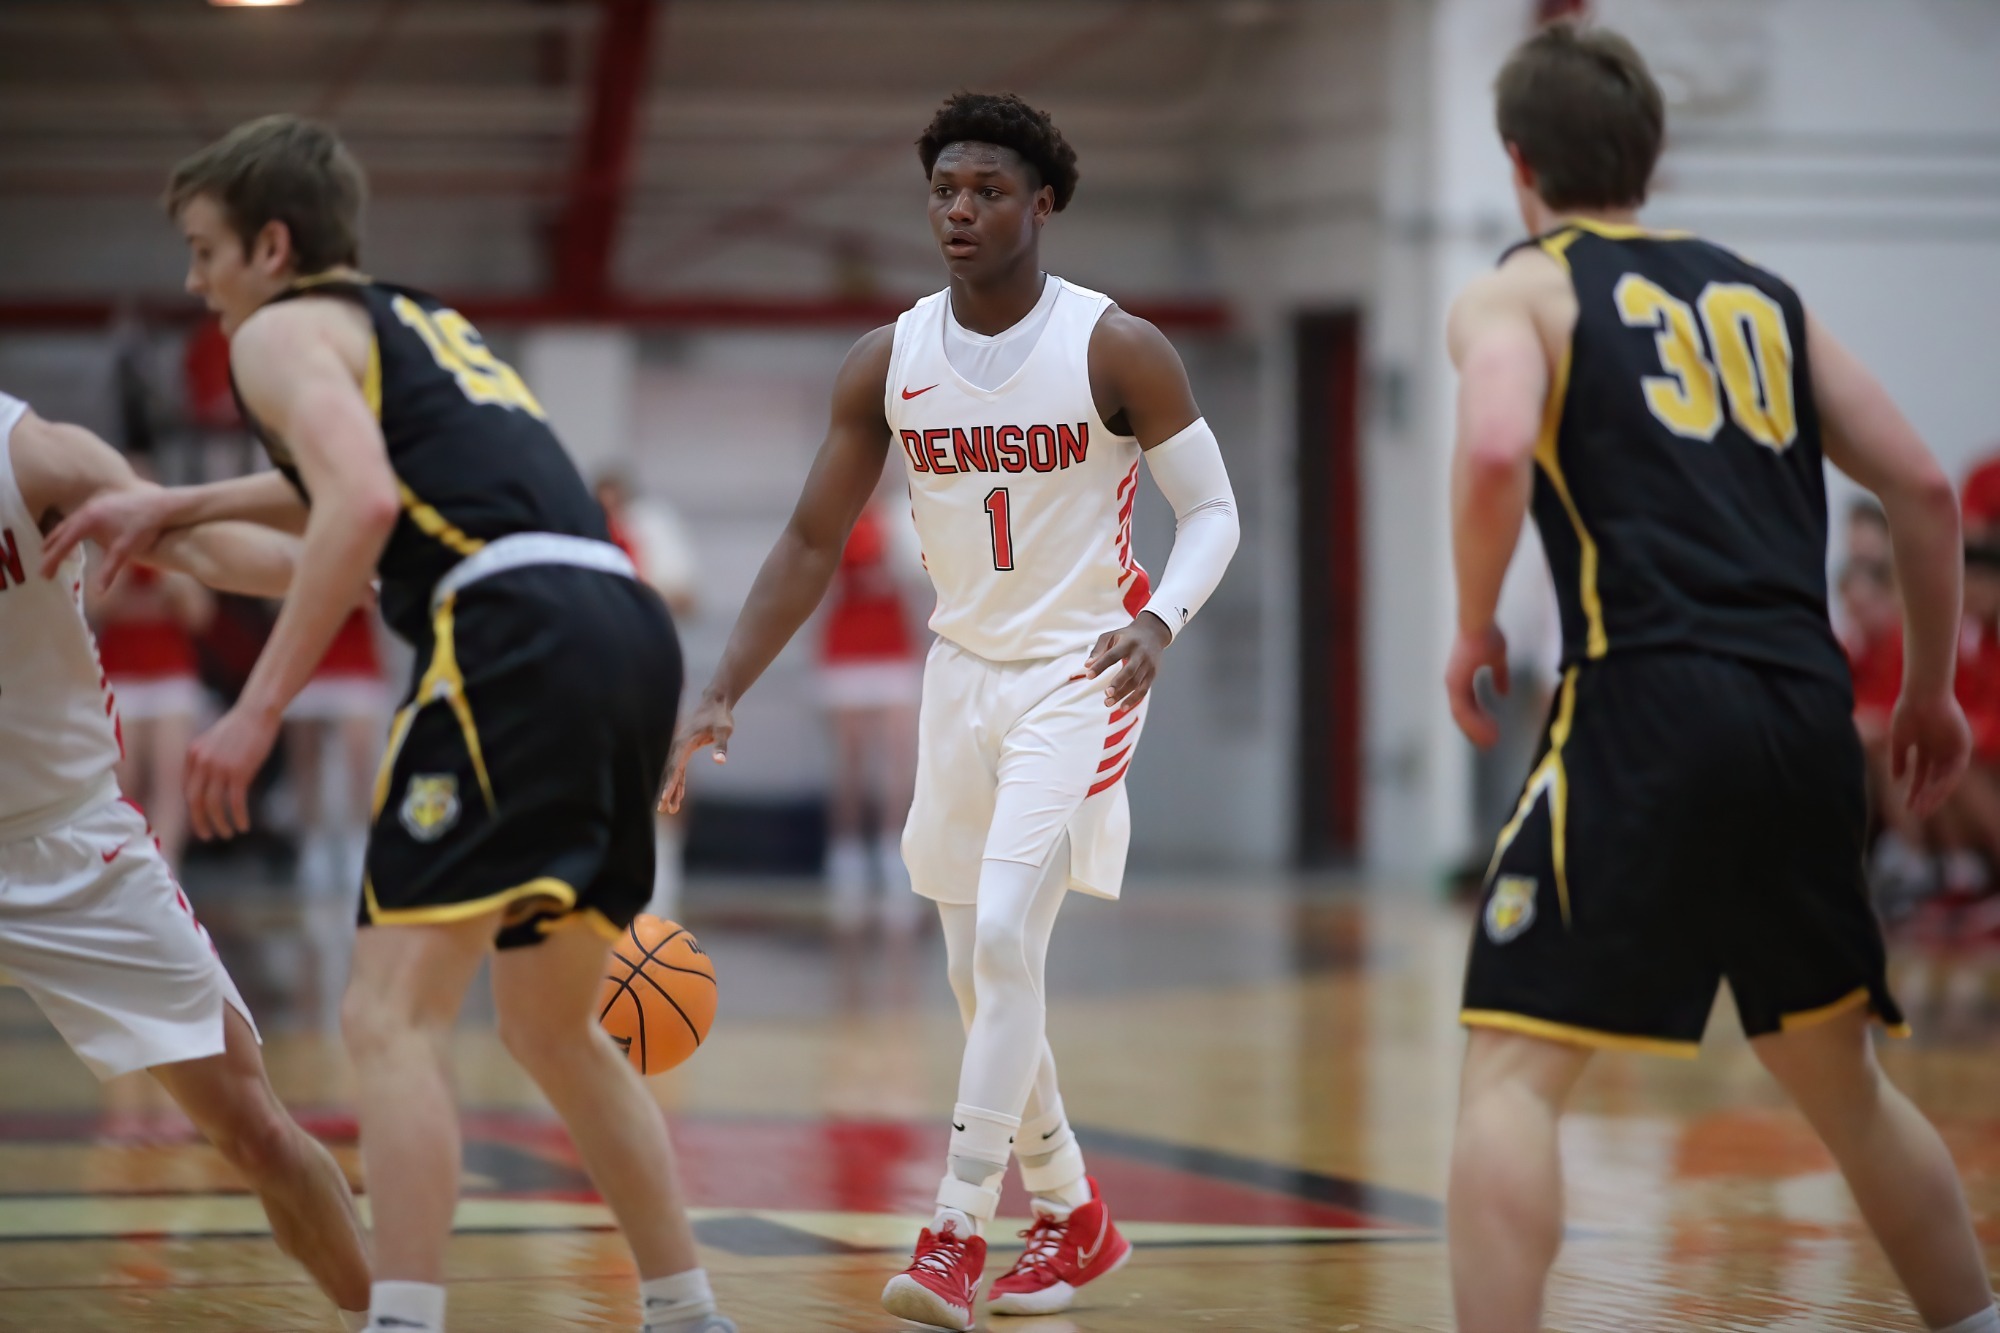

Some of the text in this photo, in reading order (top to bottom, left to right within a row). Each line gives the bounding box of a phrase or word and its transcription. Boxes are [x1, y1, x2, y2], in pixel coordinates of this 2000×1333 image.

[1613, 272, 1798, 454] 30
[899, 422, 1089, 474] DENISON
[984, 487, 1014, 571] 1
